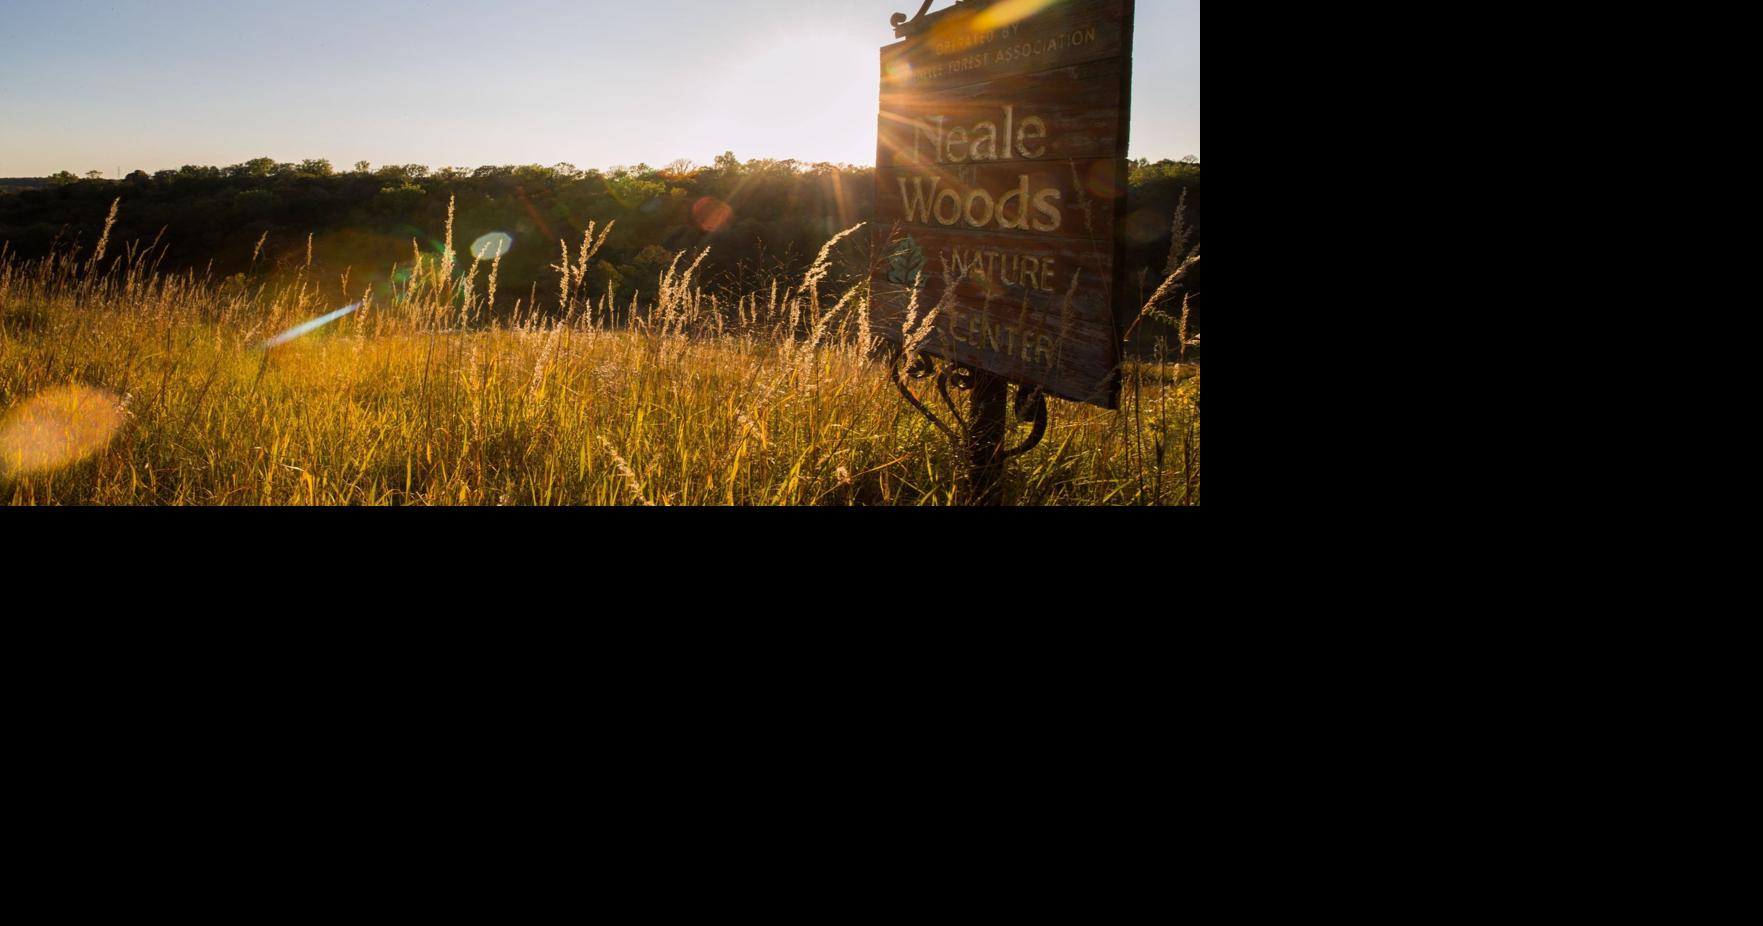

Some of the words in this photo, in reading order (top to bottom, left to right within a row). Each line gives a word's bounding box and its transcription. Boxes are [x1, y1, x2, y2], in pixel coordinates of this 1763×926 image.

[949, 52, 989, 73] FOREST
[994, 27, 1096, 64] ASSOCIATION
[1002, 24, 1019, 39] BY
[912, 104, 1047, 164] Neale
[896, 174, 1062, 232] Woods
[951, 247, 1055, 292] NATURE
[949, 312, 1055, 369] CENTER
